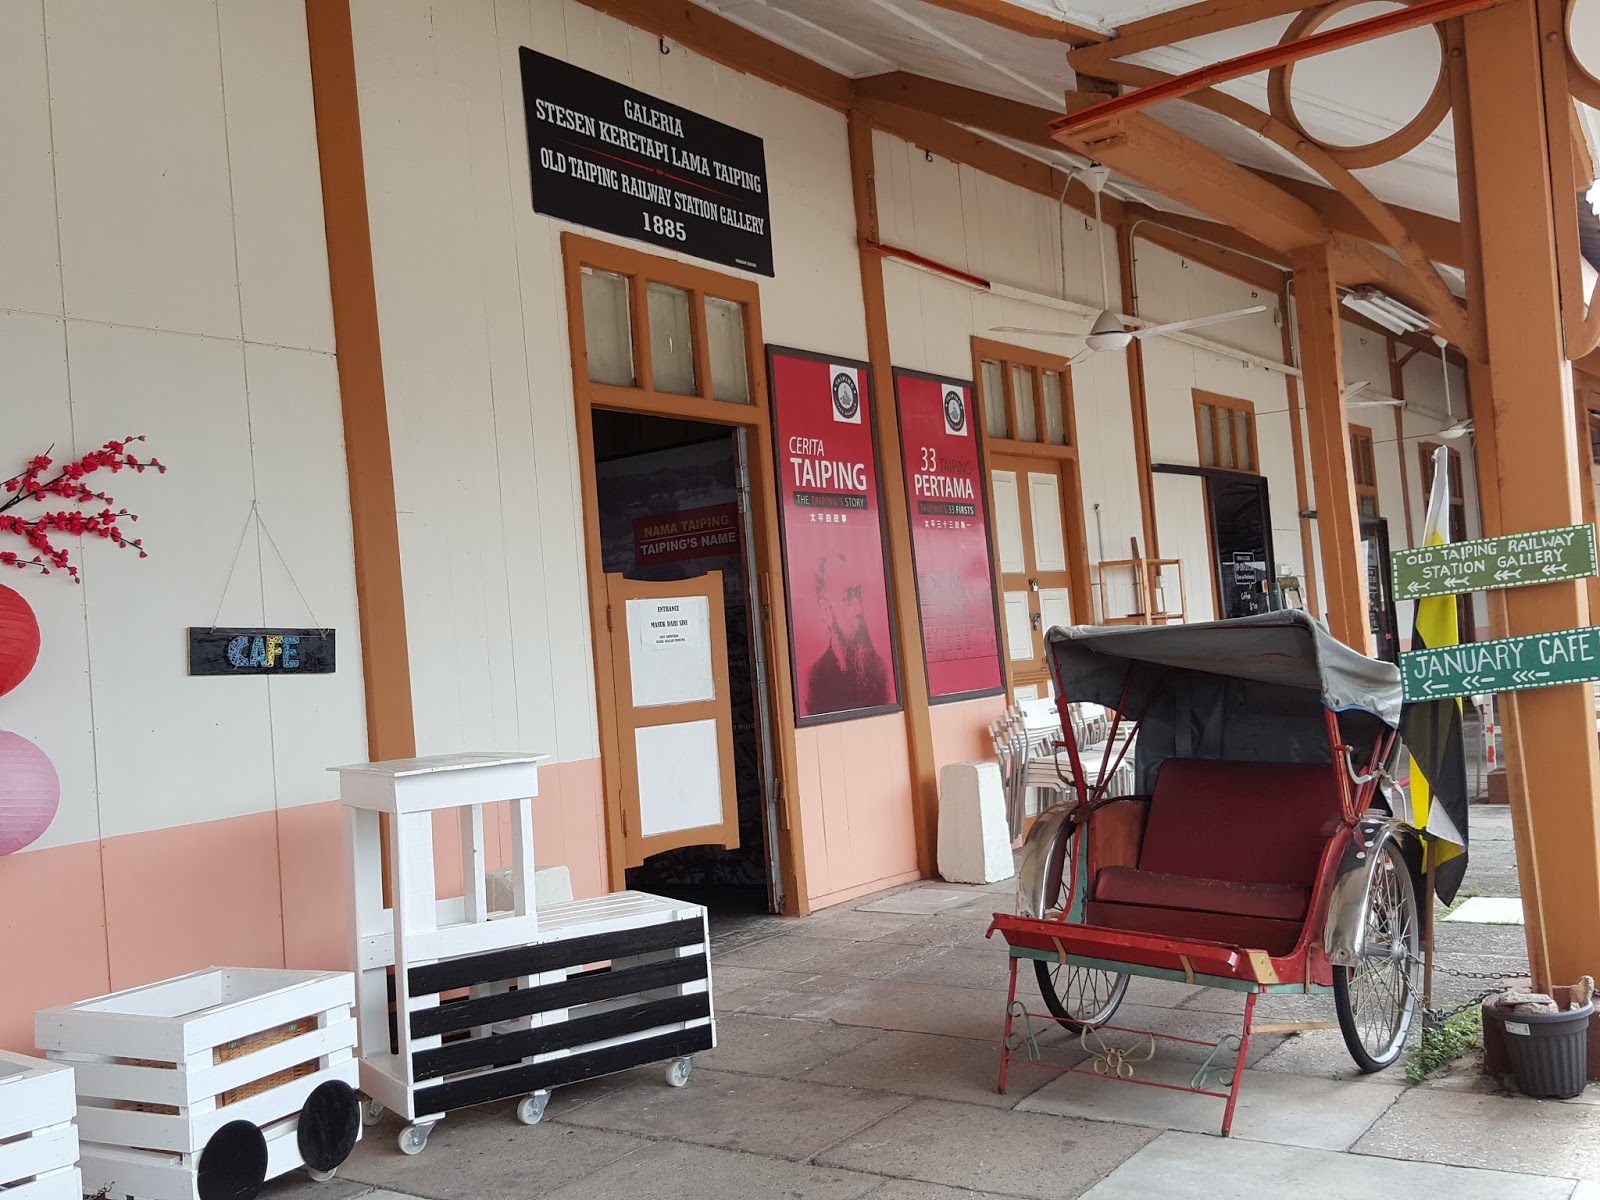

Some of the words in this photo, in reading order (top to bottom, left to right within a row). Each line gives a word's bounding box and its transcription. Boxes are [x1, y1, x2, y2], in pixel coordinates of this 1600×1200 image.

[623, 99, 685, 138] GALERIA
[535, 98, 596, 138] STESEN
[599, 120, 670, 163] KERETAPI
[672, 146, 710, 177] LAMA
[712, 160, 762, 194] TAIPING
[540, 147, 566, 174] OLD
[568, 156, 618, 190] TAIPING
[621, 175, 672, 207] RAILWAY
[674, 191, 718, 221] STATION
[719, 206, 764, 235] GALLERY
[642, 211, 687, 241] 1885
[788, 436, 825, 457] CERITA
[920, 446, 937, 472] 33
[939, 458, 972, 475] TAIPING
[790, 457, 867, 491] TAIPING
[914, 473, 975, 500] PERTAMA
[796, 494, 810, 505] THE
[810, 495, 844, 507] TAIPING'S
[844, 497, 864, 507] STORY
[948, 505, 955, 514] 33
[955, 505, 974, 515] FIRSTS
[643, 523, 678, 538] NAMA
[681, 515, 730, 531] TAIPING
[640, 537, 698, 556] TAIPING'S
[701, 532, 737, 547] NAME
[1406, 552, 1433, 566] OLD
[1441, 542, 1498, 561] TAIPING
[1507, 532, 1575, 553] RAILWAY
[1422, 559, 1486, 579] STATION
[1497, 549, 1563, 569] GALLERY
[657, 605, 680, 613] ENTRANCE
[227, 635, 300, 668] CAFE
[1413, 642, 1524, 679] JANUARY
[1538, 633, 1595, 665] CAFE
